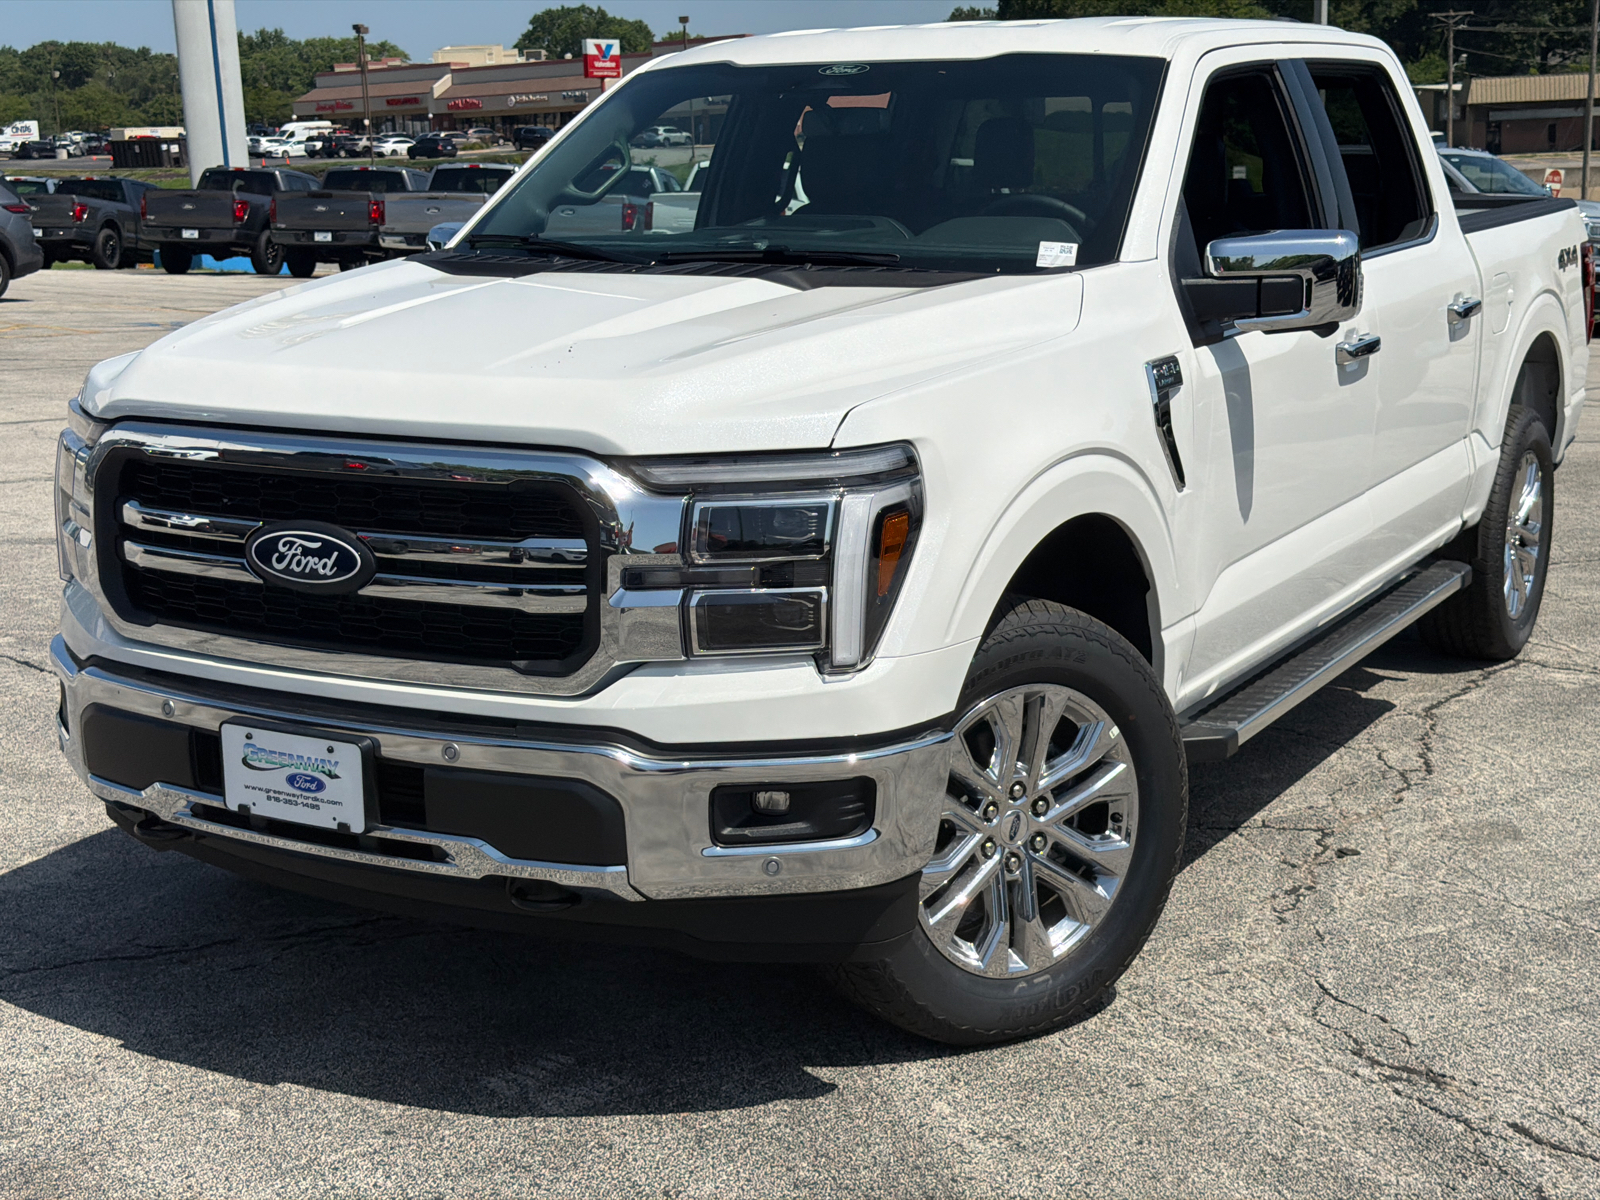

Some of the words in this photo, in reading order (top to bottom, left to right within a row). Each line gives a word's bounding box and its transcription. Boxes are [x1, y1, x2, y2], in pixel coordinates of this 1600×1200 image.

[271, 536, 339, 576] Ford
[242, 742, 340, 776] GREENWAY
[294, 774, 319, 791] Ford
